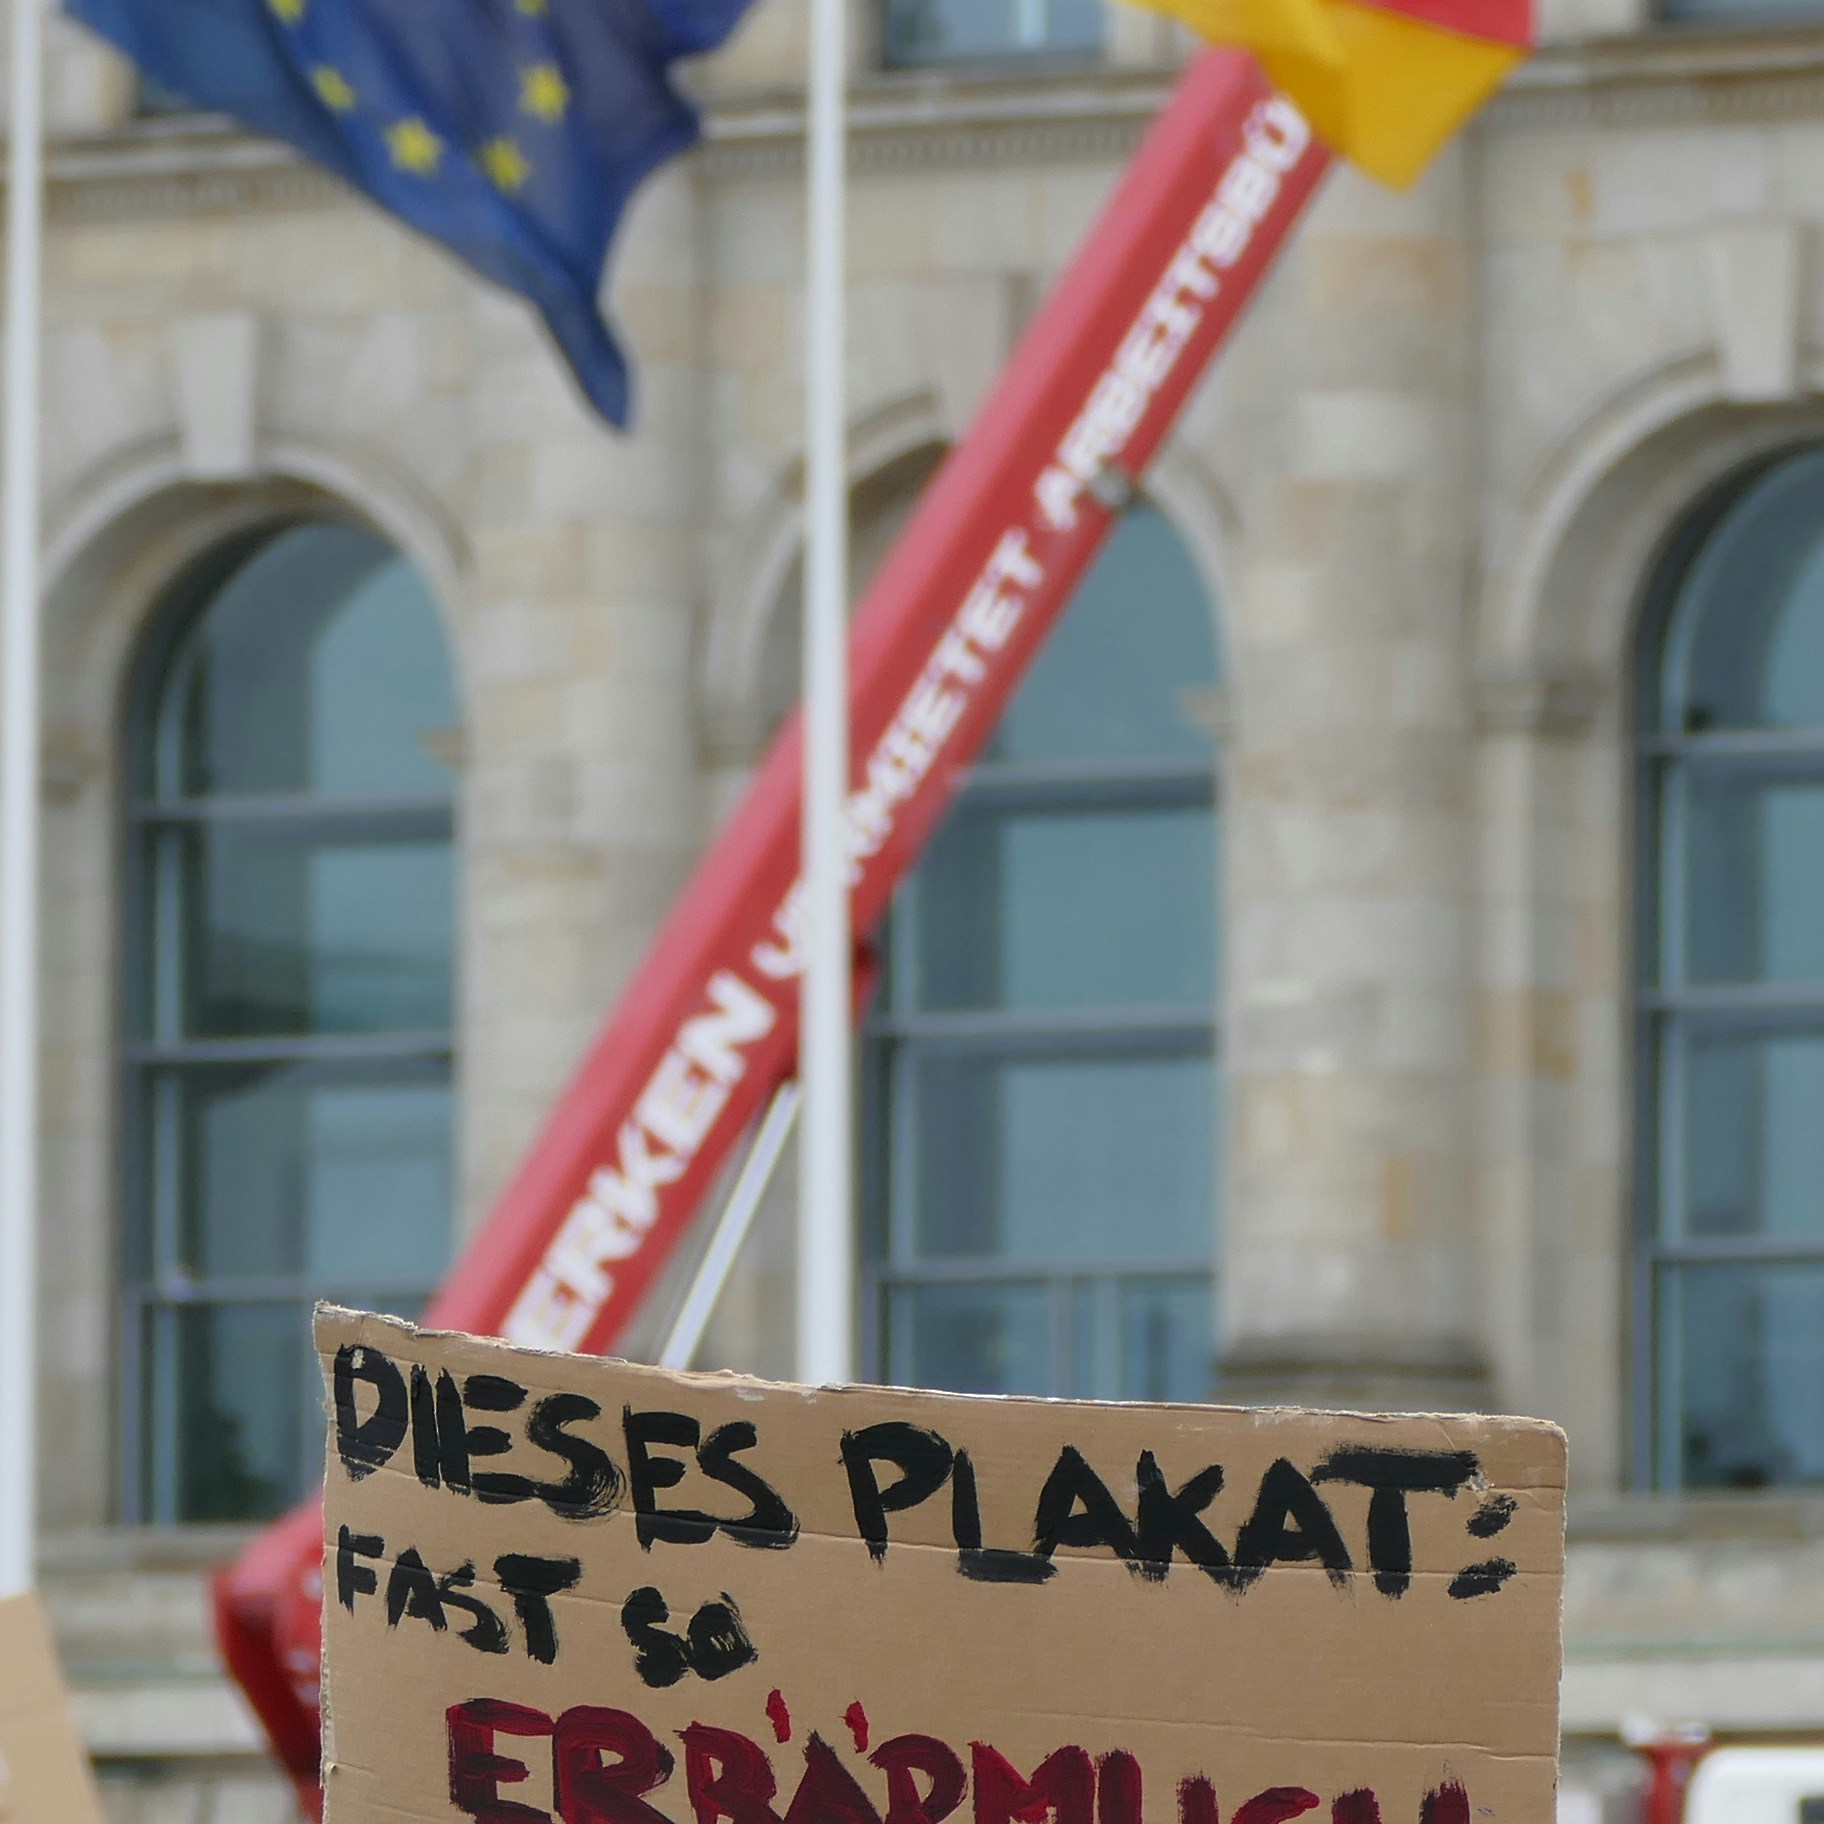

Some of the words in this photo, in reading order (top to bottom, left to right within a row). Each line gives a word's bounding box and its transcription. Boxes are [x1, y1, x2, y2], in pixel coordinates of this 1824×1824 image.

[334, 1344, 802, 1552] DIESES
[838, 1422, 1517, 1599] PLAKAT:
[337, 1525, 580, 1664] FAST
[621, 1587, 758, 1688] SO
